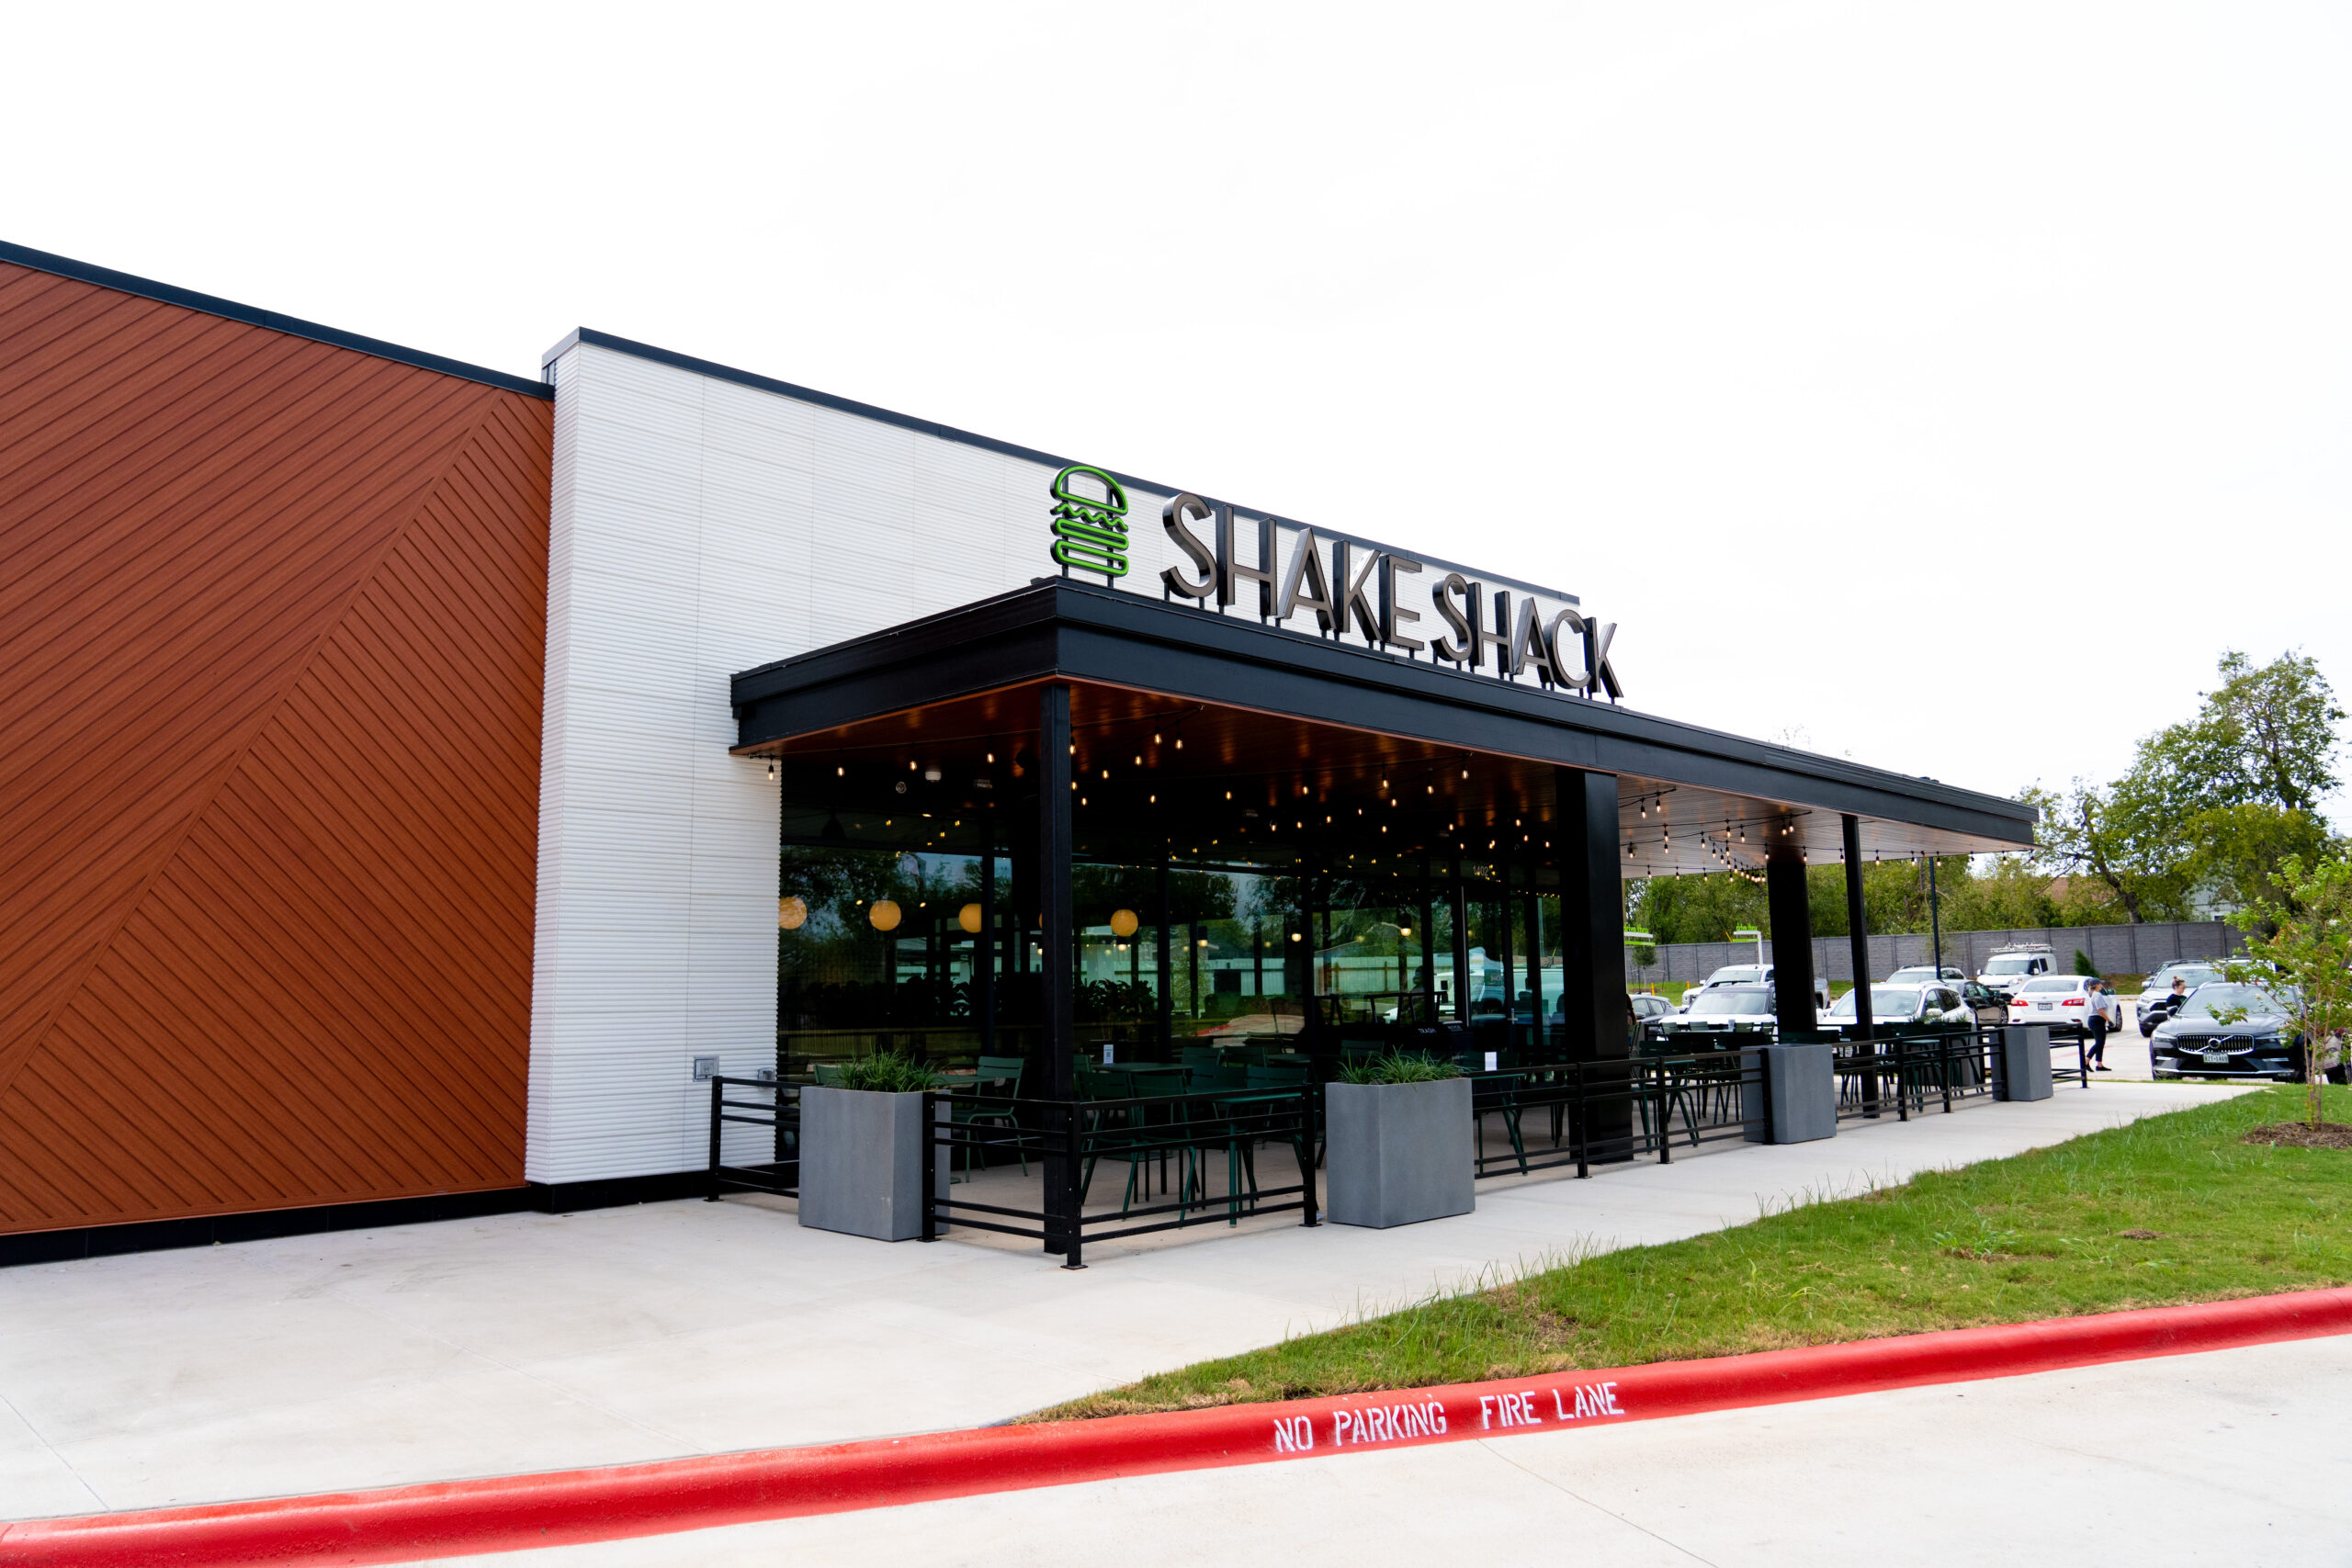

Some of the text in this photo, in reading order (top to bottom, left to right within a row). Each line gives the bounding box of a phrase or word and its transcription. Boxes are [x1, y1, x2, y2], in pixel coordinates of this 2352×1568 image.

[1159, 493, 1624, 698] SHAKE SHACK
[1273, 1382, 1625, 1452] NO PARKING FIRE LANE
